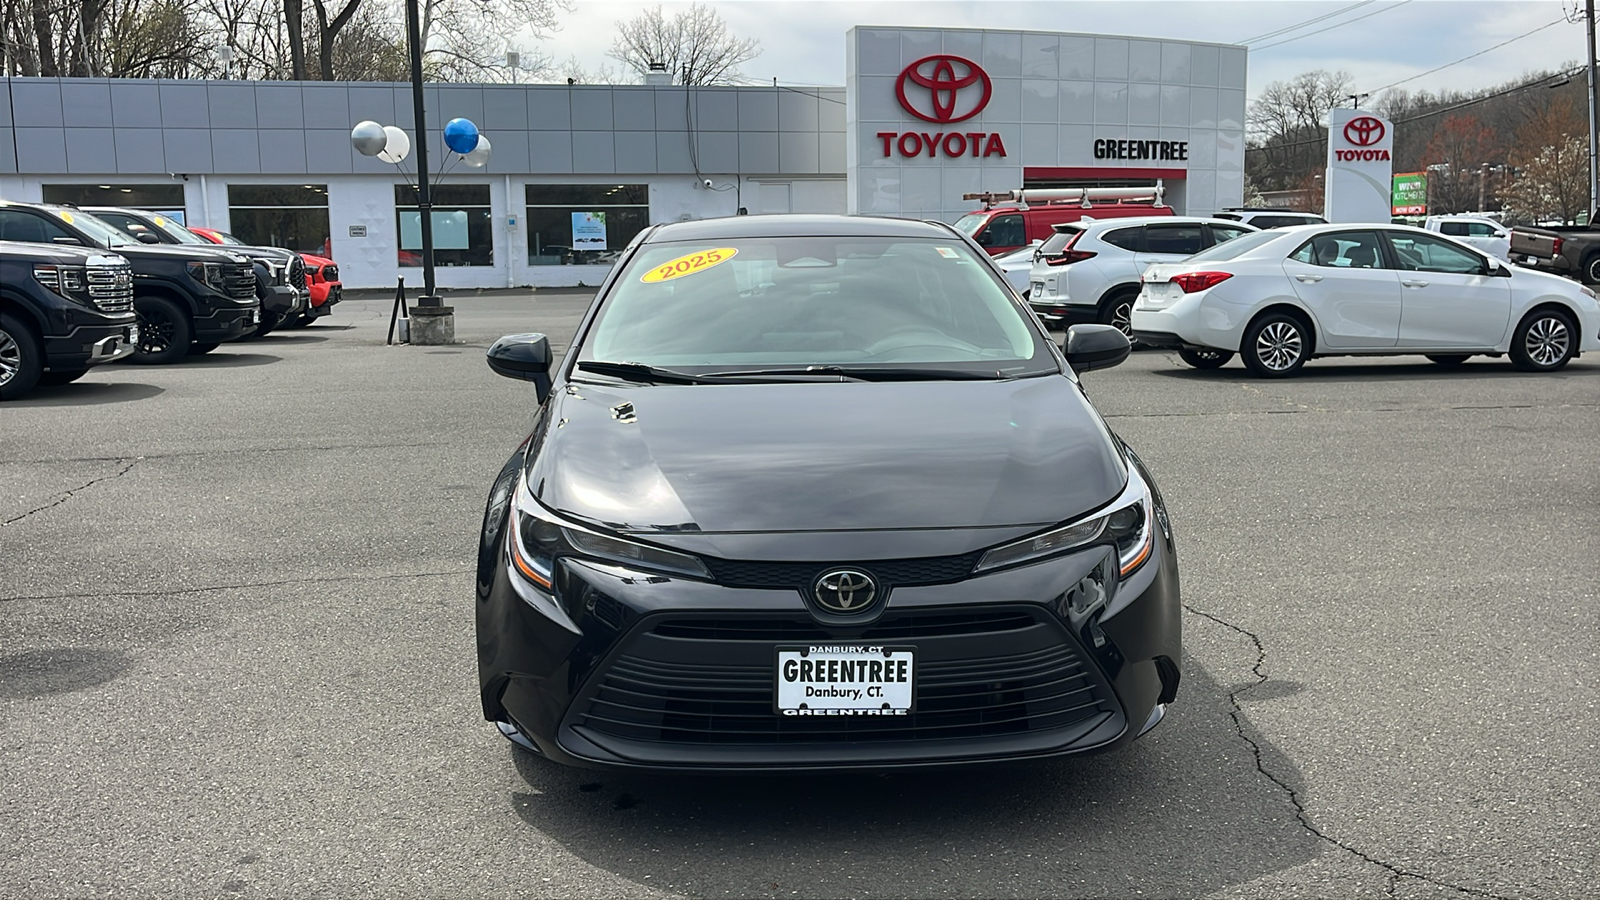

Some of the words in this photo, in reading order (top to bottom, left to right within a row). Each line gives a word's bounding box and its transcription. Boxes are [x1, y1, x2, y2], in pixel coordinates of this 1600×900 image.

[877, 132, 1007, 158] TOYOTA
[1093, 138, 1188, 160] GREENTREE
[1335, 149, 1390, 161] TOYOTA
[660, 250, 722, 279] 2025
[809, 646, 866, 654] DANBURY,
[783, 659, 908, 682] GREENTREE
[805, 685, 863, 701] Danbury,
[866, 686, 884, 697] CT.
